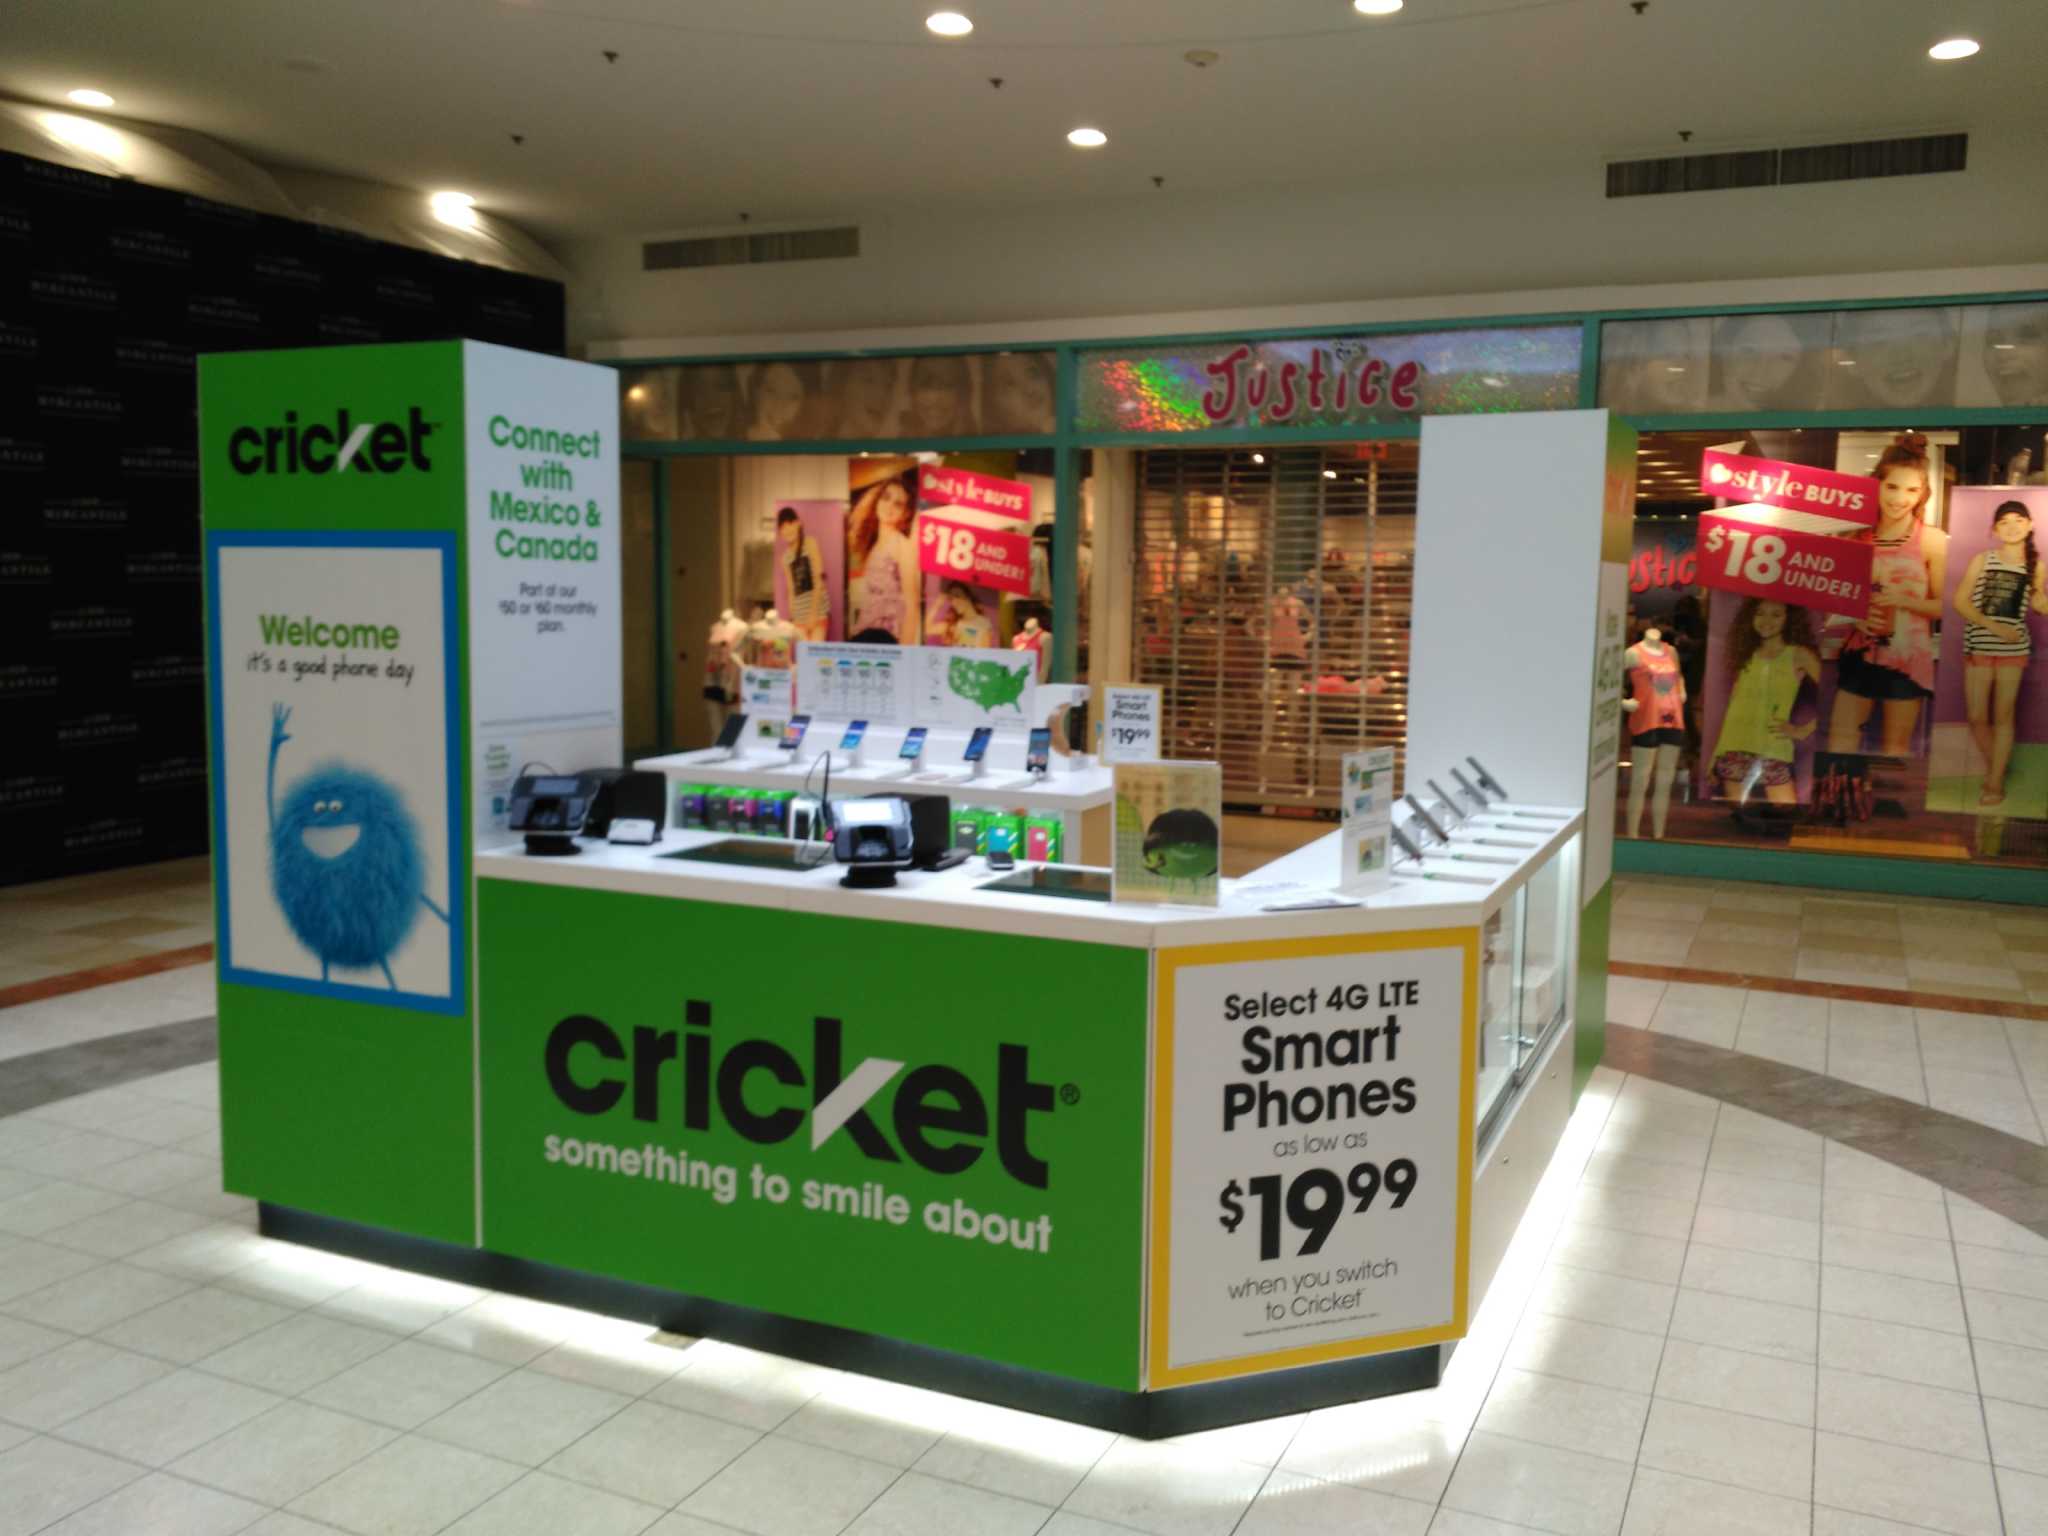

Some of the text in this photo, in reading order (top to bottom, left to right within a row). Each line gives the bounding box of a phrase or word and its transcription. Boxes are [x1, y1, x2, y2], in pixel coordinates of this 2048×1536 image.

[1203, 345, 1419, 420] Justice
[228, 406, 433, 476] cricket
[488, 415, 601, 459] Connect
[520, 460, 573, 491] with
[1730, 469, 1865, 510] style BUYS
[490, 490, 601, 527] Mexico &
[495, 529, 599, 562] Canada
[923, 522, 977, 571] $18
[1704, 523, 1788, 585] $18
[1787, 551, 1836, 573] AND
[1783, 569, 1863, 600] UNDER!
[258, 613, 401, 651] Welcome
[293, 654, 327, 683] good
[332, 653, 379, 682] phone
[385, 657, 416, 688] day
[1223, 980, 1420, 1022] Select 4G LTE
[1240, 1014, 1401, 1076] Smart
[544, 999, 1057, 1191] cricket
[1222, 1077, 1418, 1133] Phones
[1272, 1130, 1368, 1158] as low as
[544, 1132, 1053, 1254] something to smile about
[1227, 1256, 1399, 1301] when you switch
[1265, 1289, 1363, 1323] to Cricket
